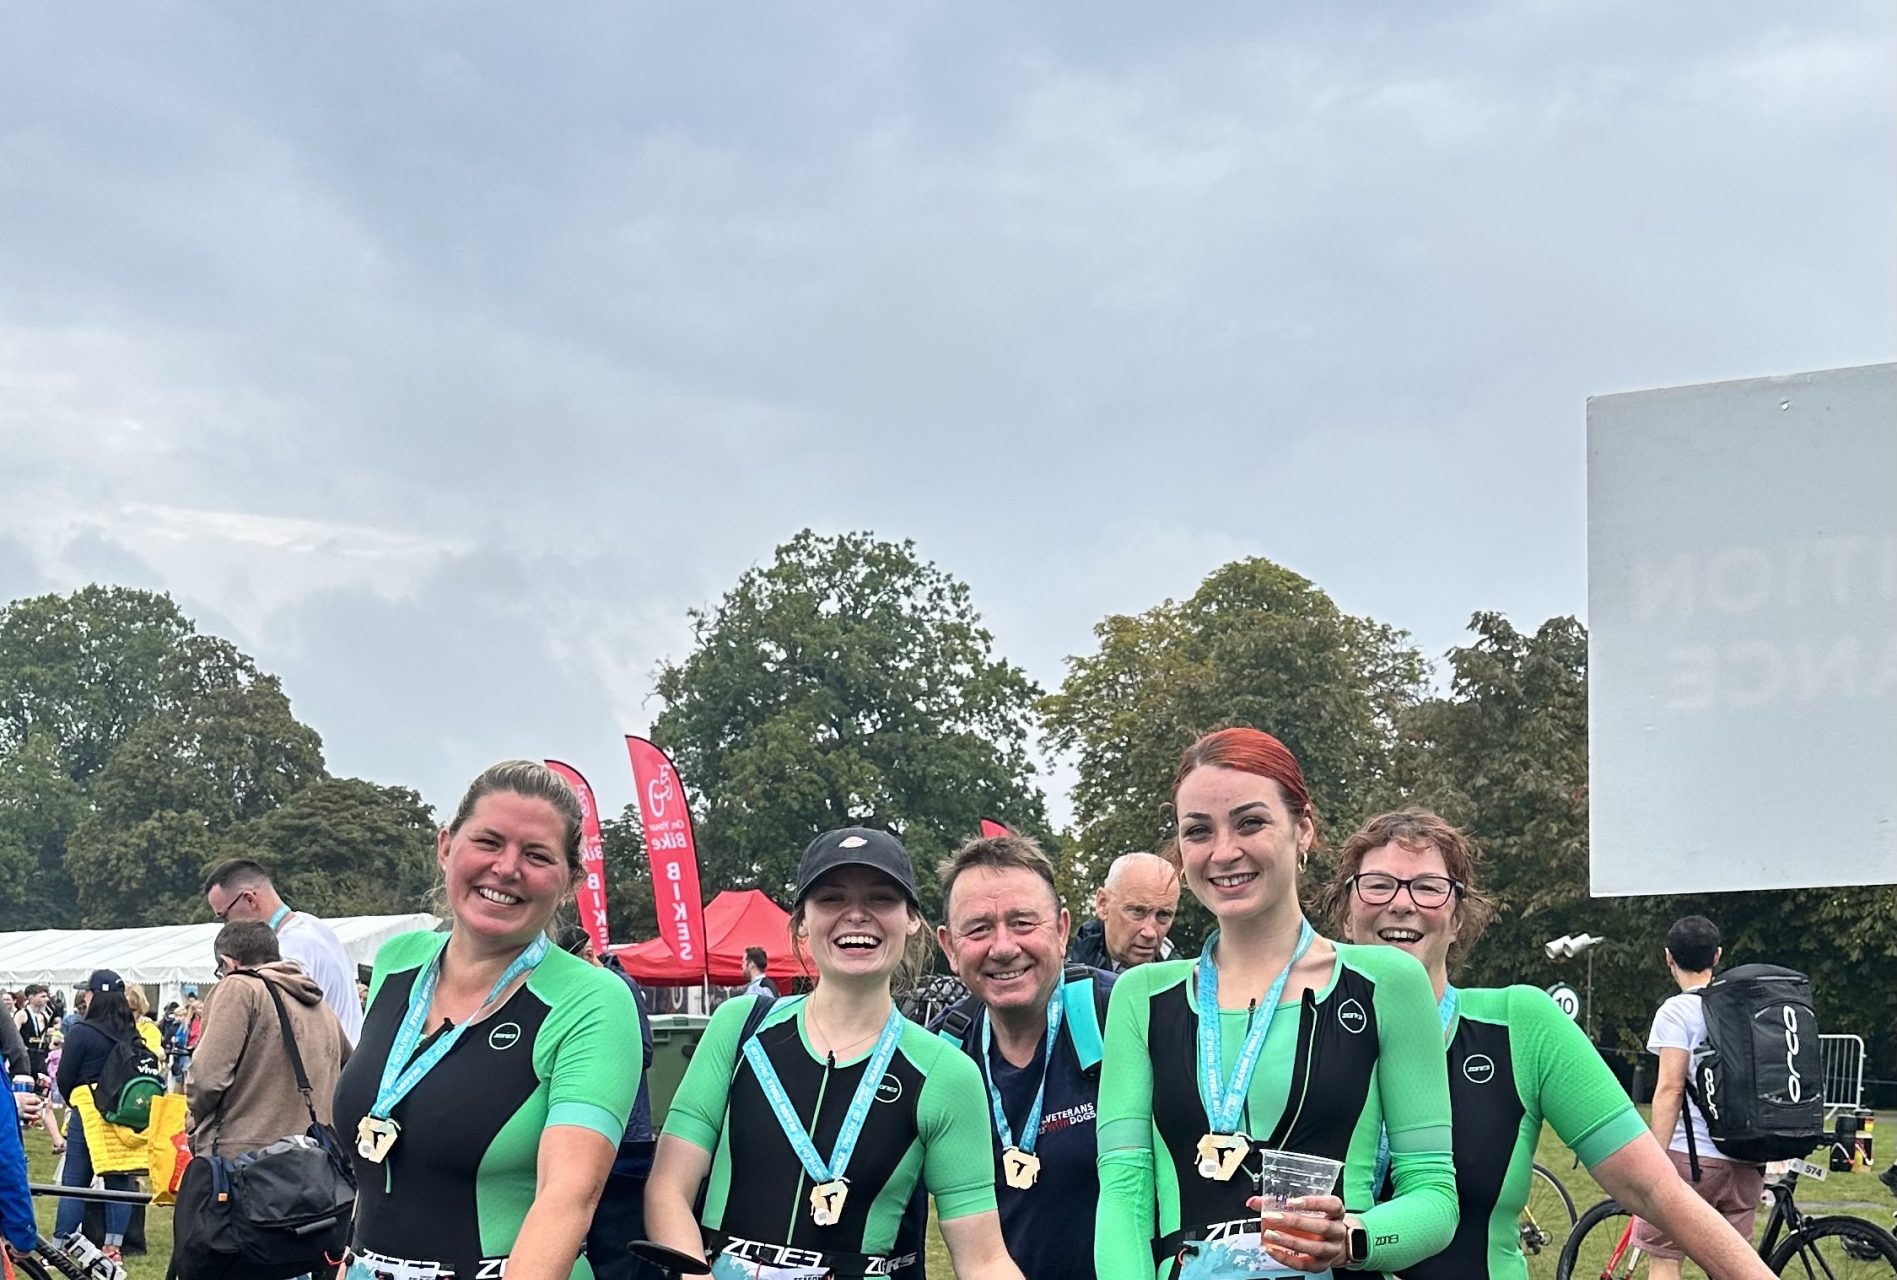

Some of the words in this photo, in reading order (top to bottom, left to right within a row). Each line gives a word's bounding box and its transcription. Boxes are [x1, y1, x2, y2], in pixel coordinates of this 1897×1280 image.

[1783, 1005, 1801, 1103] orca
[1045, 1102, 1094, 1123] VETERANS
[1069, 1110, 1096, 1125] DOGS
[1804, 1164, 1823, 1177] 574
